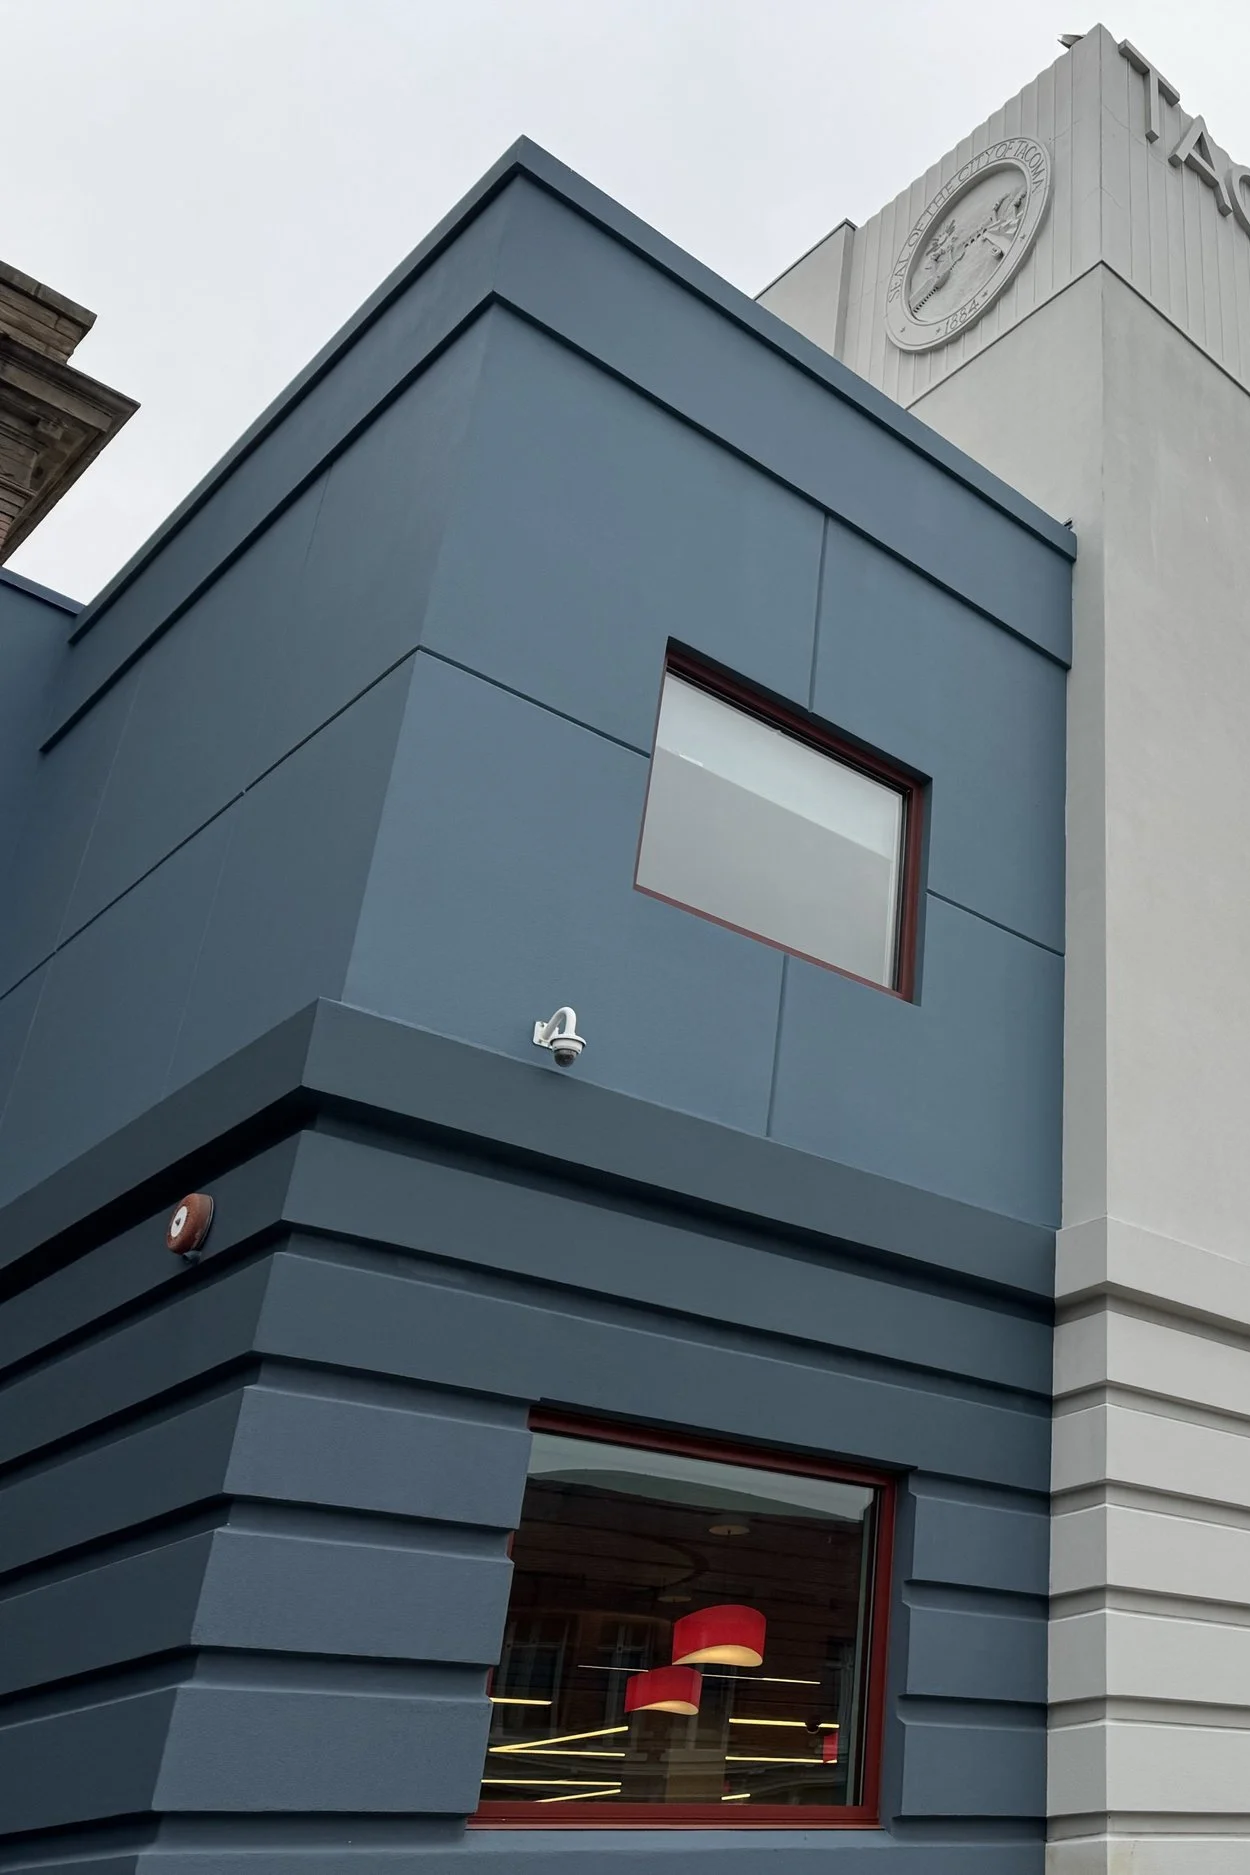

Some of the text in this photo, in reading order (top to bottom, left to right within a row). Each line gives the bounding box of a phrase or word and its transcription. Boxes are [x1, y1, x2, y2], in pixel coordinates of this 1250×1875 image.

[923, 183, 954, 217] THE
[958, 147, 997, 182] CITY
[996, 141, 1016, 159] OF
[1014, 140, 1046, 195] TACOMA
[945, 299, 979, 335] 1884
